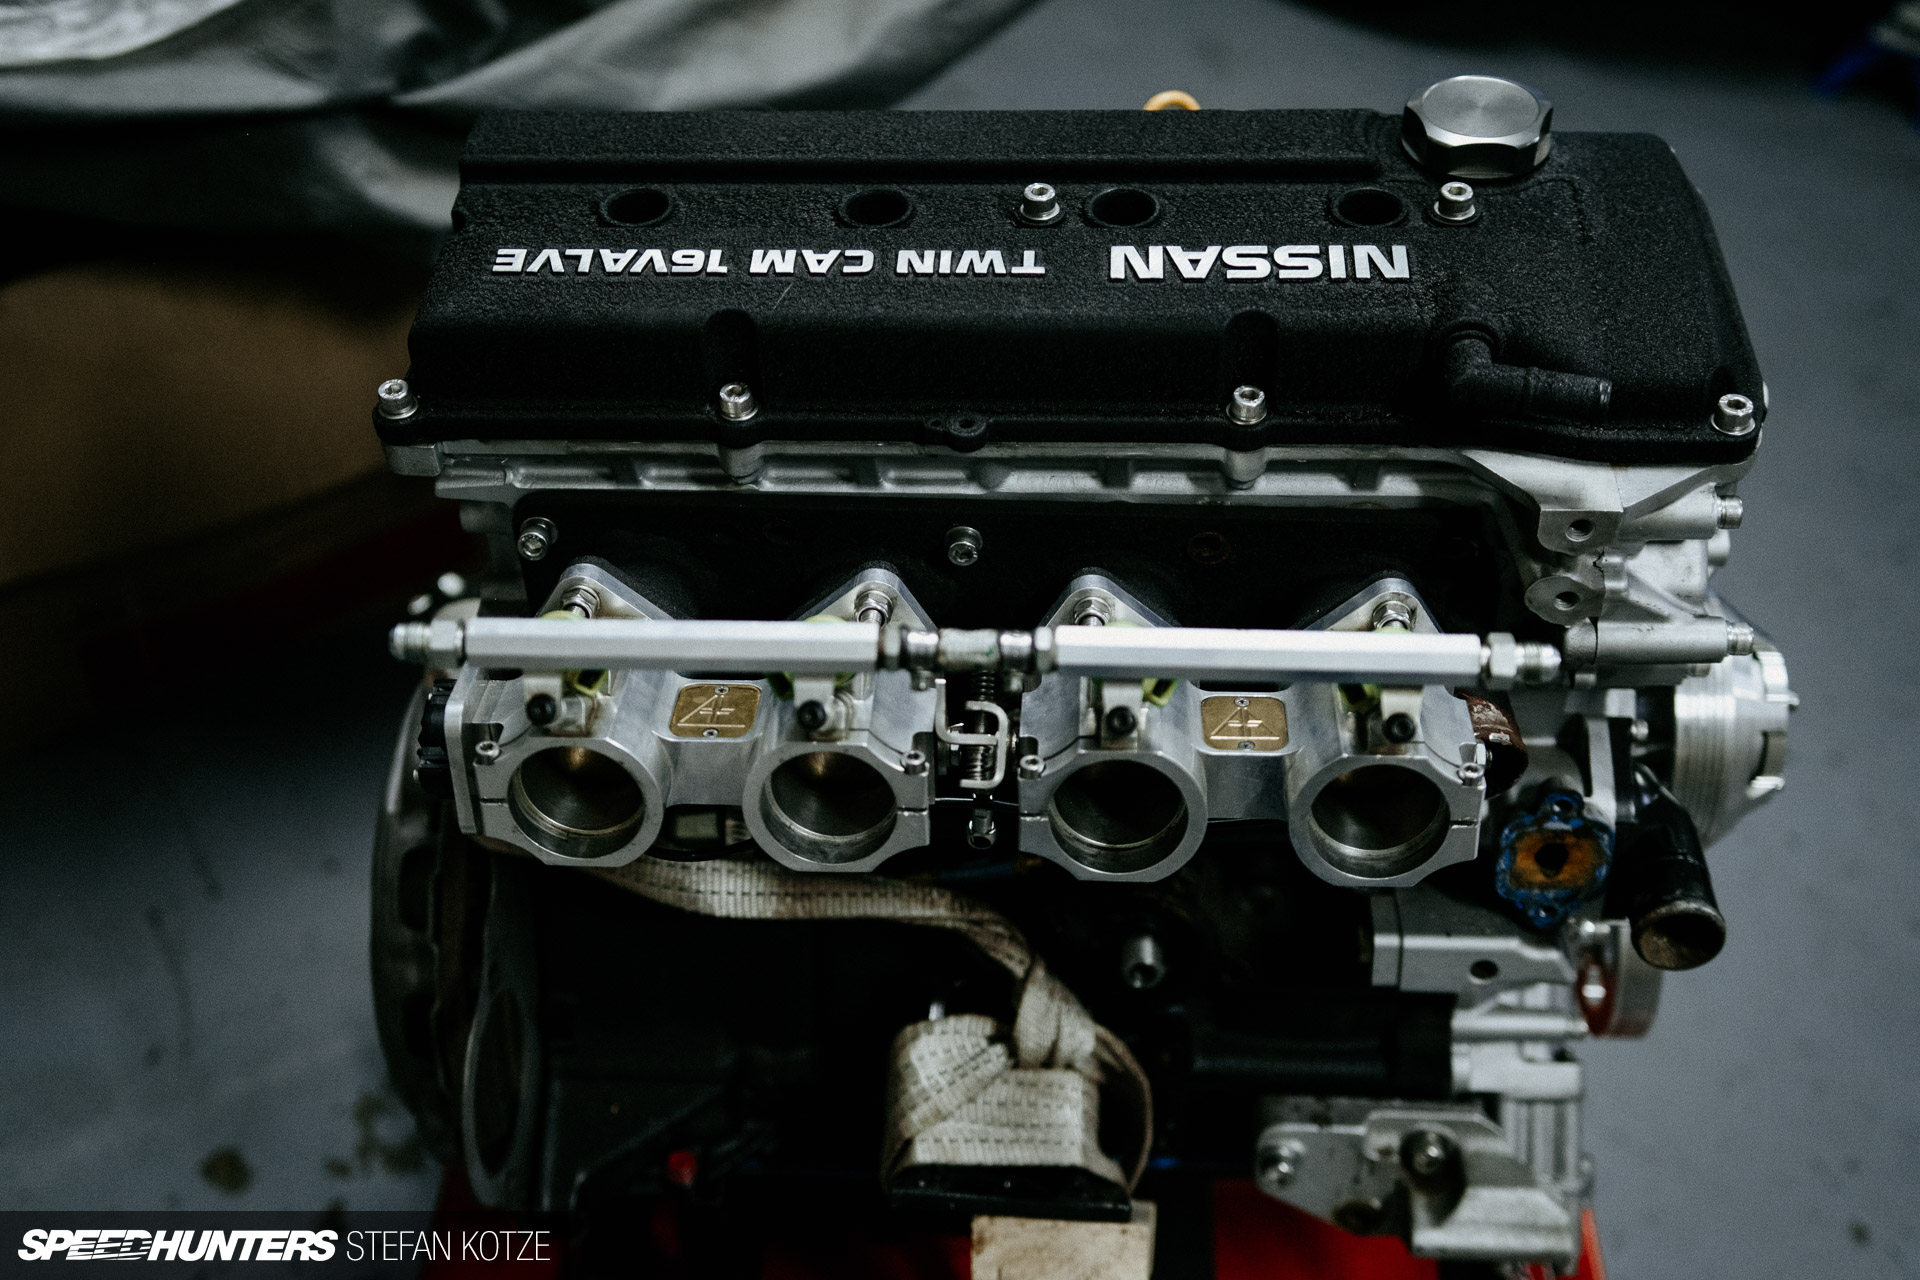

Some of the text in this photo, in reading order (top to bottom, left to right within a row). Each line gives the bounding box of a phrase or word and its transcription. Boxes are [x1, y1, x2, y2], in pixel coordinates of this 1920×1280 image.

[491, 243, 1411, 281] NISSAN TWIN CAM 16VALVE
